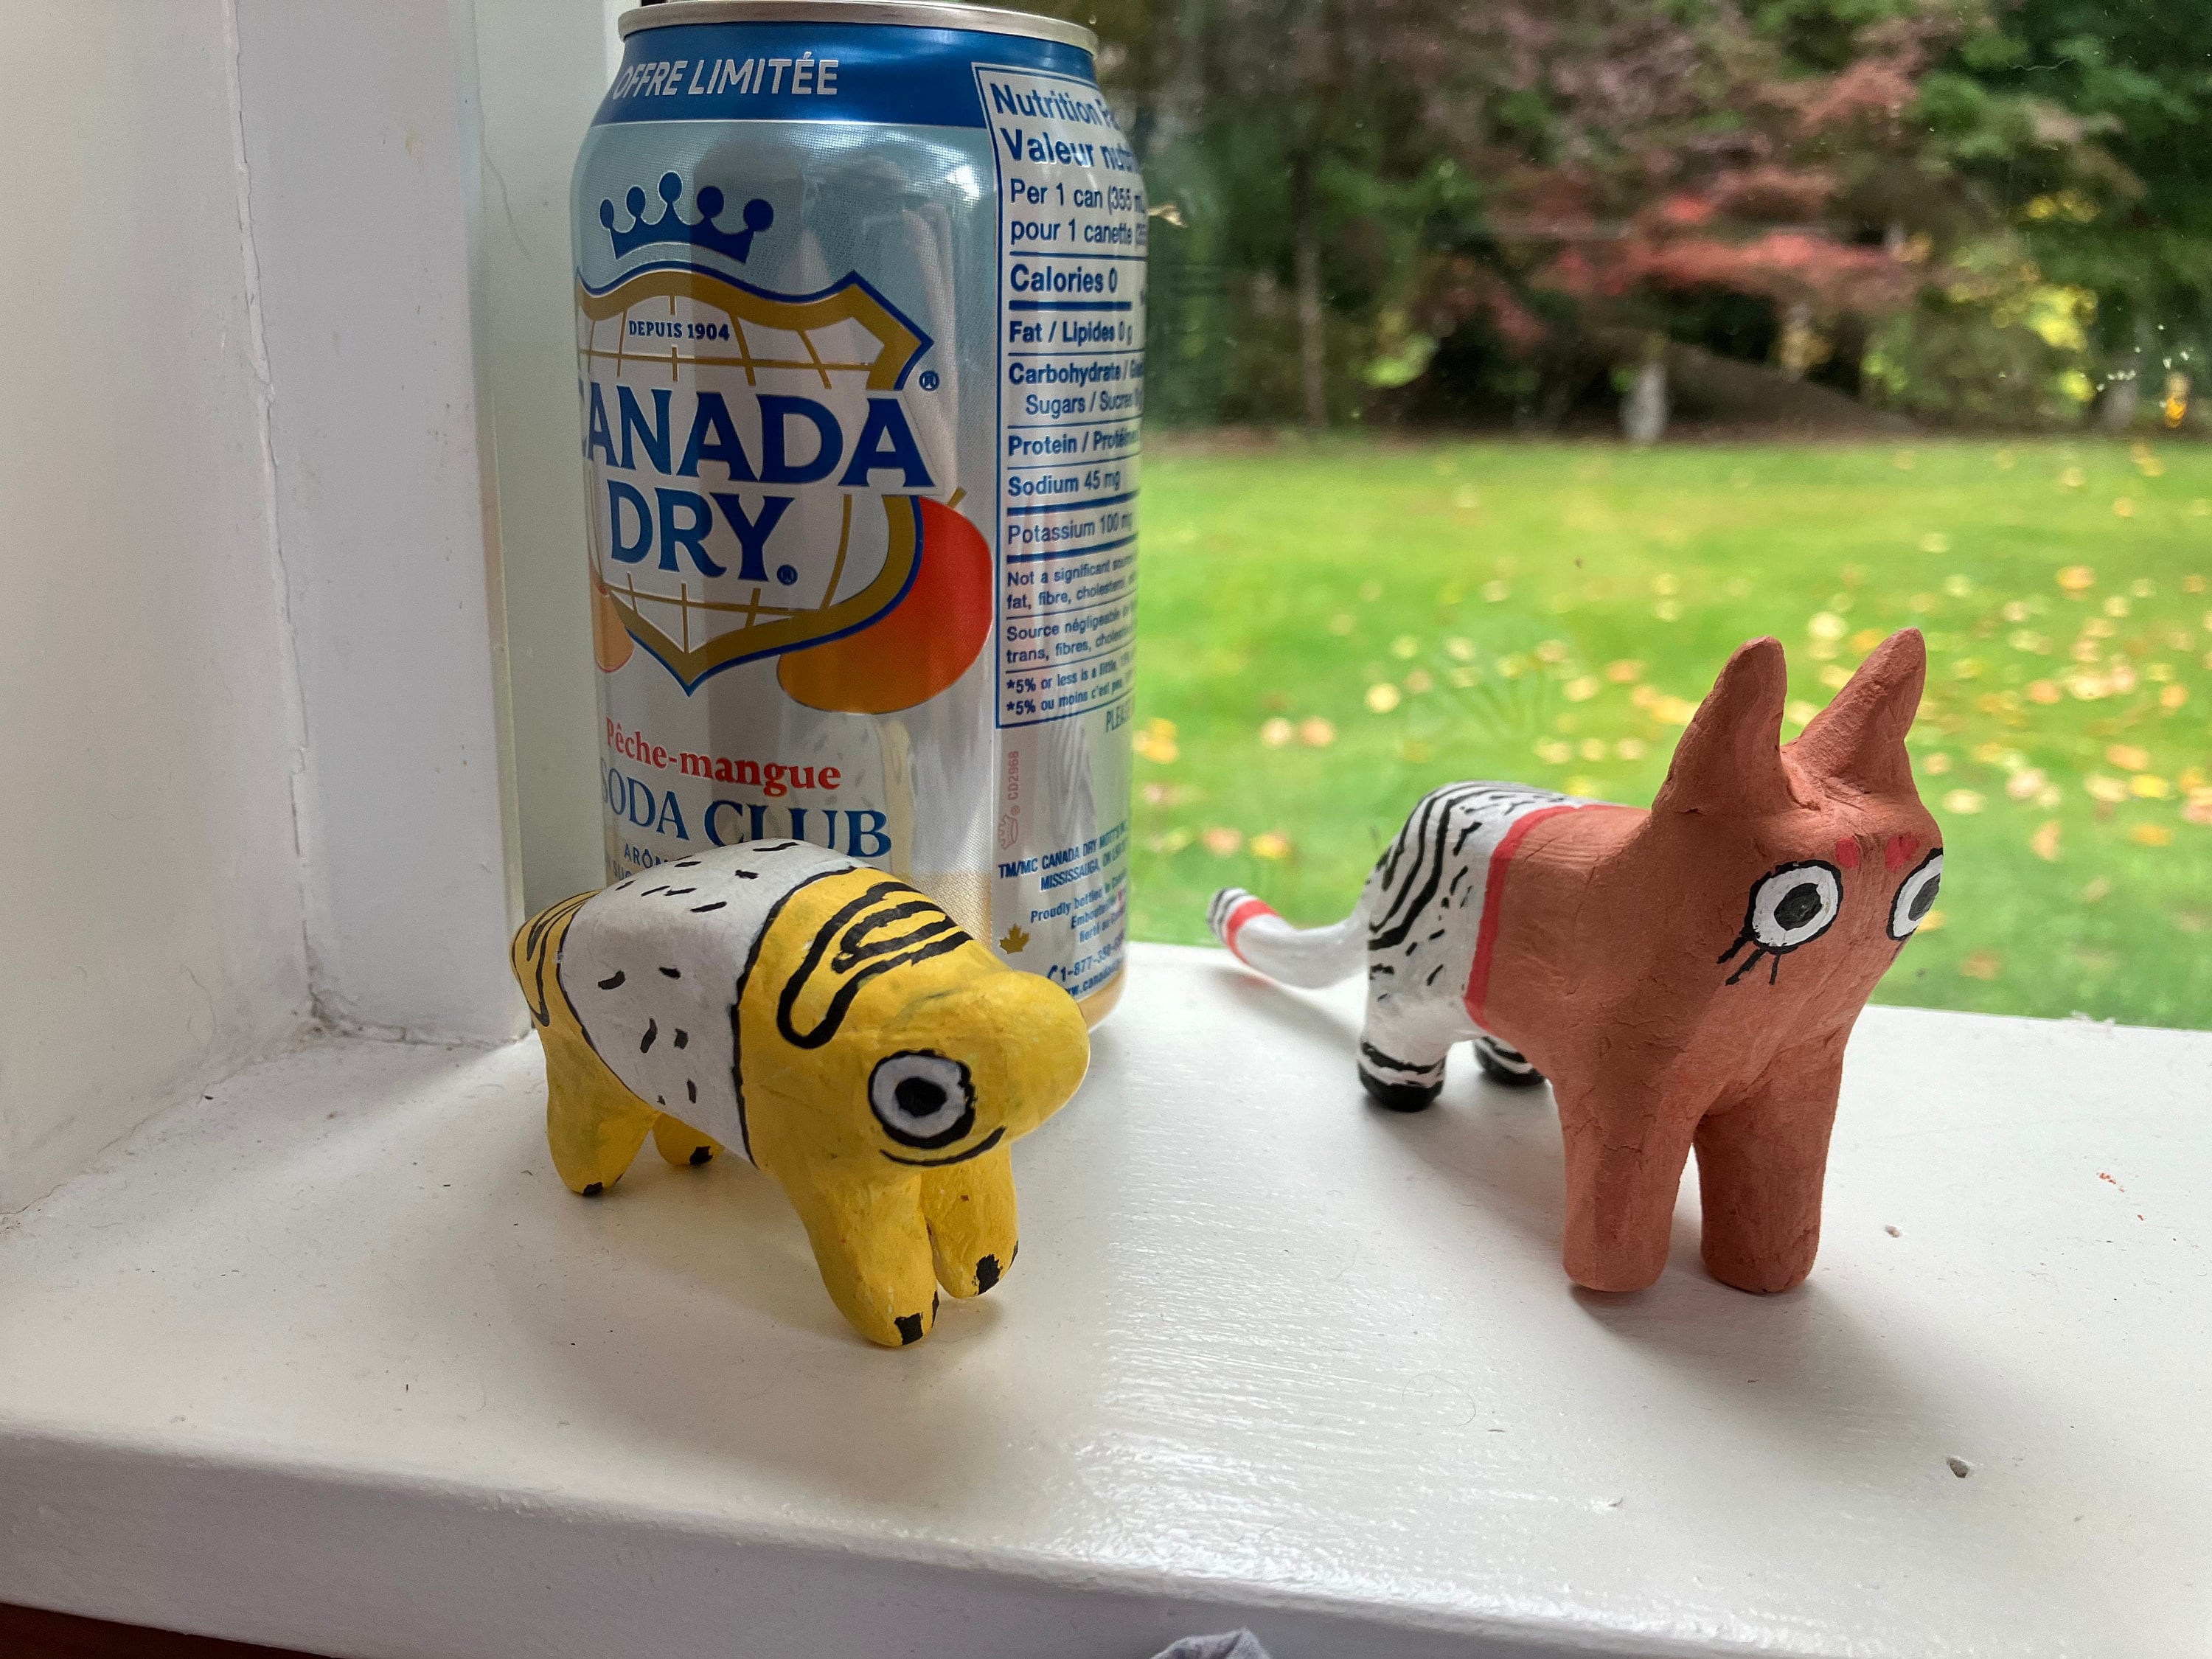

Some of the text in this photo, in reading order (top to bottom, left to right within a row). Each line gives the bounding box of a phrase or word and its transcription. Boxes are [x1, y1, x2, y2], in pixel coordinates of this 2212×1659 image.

[613, 52, 838, 100] OFFRE LIMITÉE
[990, 83, 1102, 125] Nutrition
[1001, 128, 1094, 167] Valeur
[1011, 178, 1048, 204] Per
[1056, 182, 1064, 206] 1
[1074, 189, 1103, 209] can
[1011, 220, 1060, 246] pour
[1068, 218, 1076, 242] 1
[1084, 222, 1133, 245] canette
[1010, 263, 1118, 293] Calories 0
[629, 320, 730, 341] DEPUIS 1904
[1009, 321, 1043, 343] Fat
[1062, 321, 1115, 347] Lipides
[1009, 362, 1121, 388] Carbohydrate
[1026, 393, 1086, 420] Sugars
[580, 380, 935, 487] ANADA
[1008, 434, 1077, 456] Protein
[1008, 474, 1079, 497] Sodium
[1084, 470, 1100, 490] 45
[607, 479, 795, 582] DRY
[1008, 520, 1096, 545] Potassium
[1100, 511, 1119, 533] 100
[1007, 571, 1035, 587] Not
[1041, 572, 1048, 583] a
[1054, 563, 1110, 584] significant
[1007, 594, 1032, 610] fat,
[1038, 589, 1071, 606] fibre,
[1006, 625, 1060, 641] Source
[1006, 648, 1049, 664] trans,
[1056, 641, 1092, 656] fibres,
[1041, 678, 1053, 689] or
[1057, 672, 1077, 687] less
[1081, 668, 1088, 681] is
[1041, 699, 1054, 712] ou
[1059, 691, 1088, 708] moins
[606, 717, 841, 797] Pêche-mangue
[998, 857, 1038, 879] TM/MC
[1041, 846, 1079, 870] CANADA
[1082, 838, 1097, 857] DRY
[1031, 901, 1071, 923] Proudly
[1074, 889, 1102, 908] bottled
